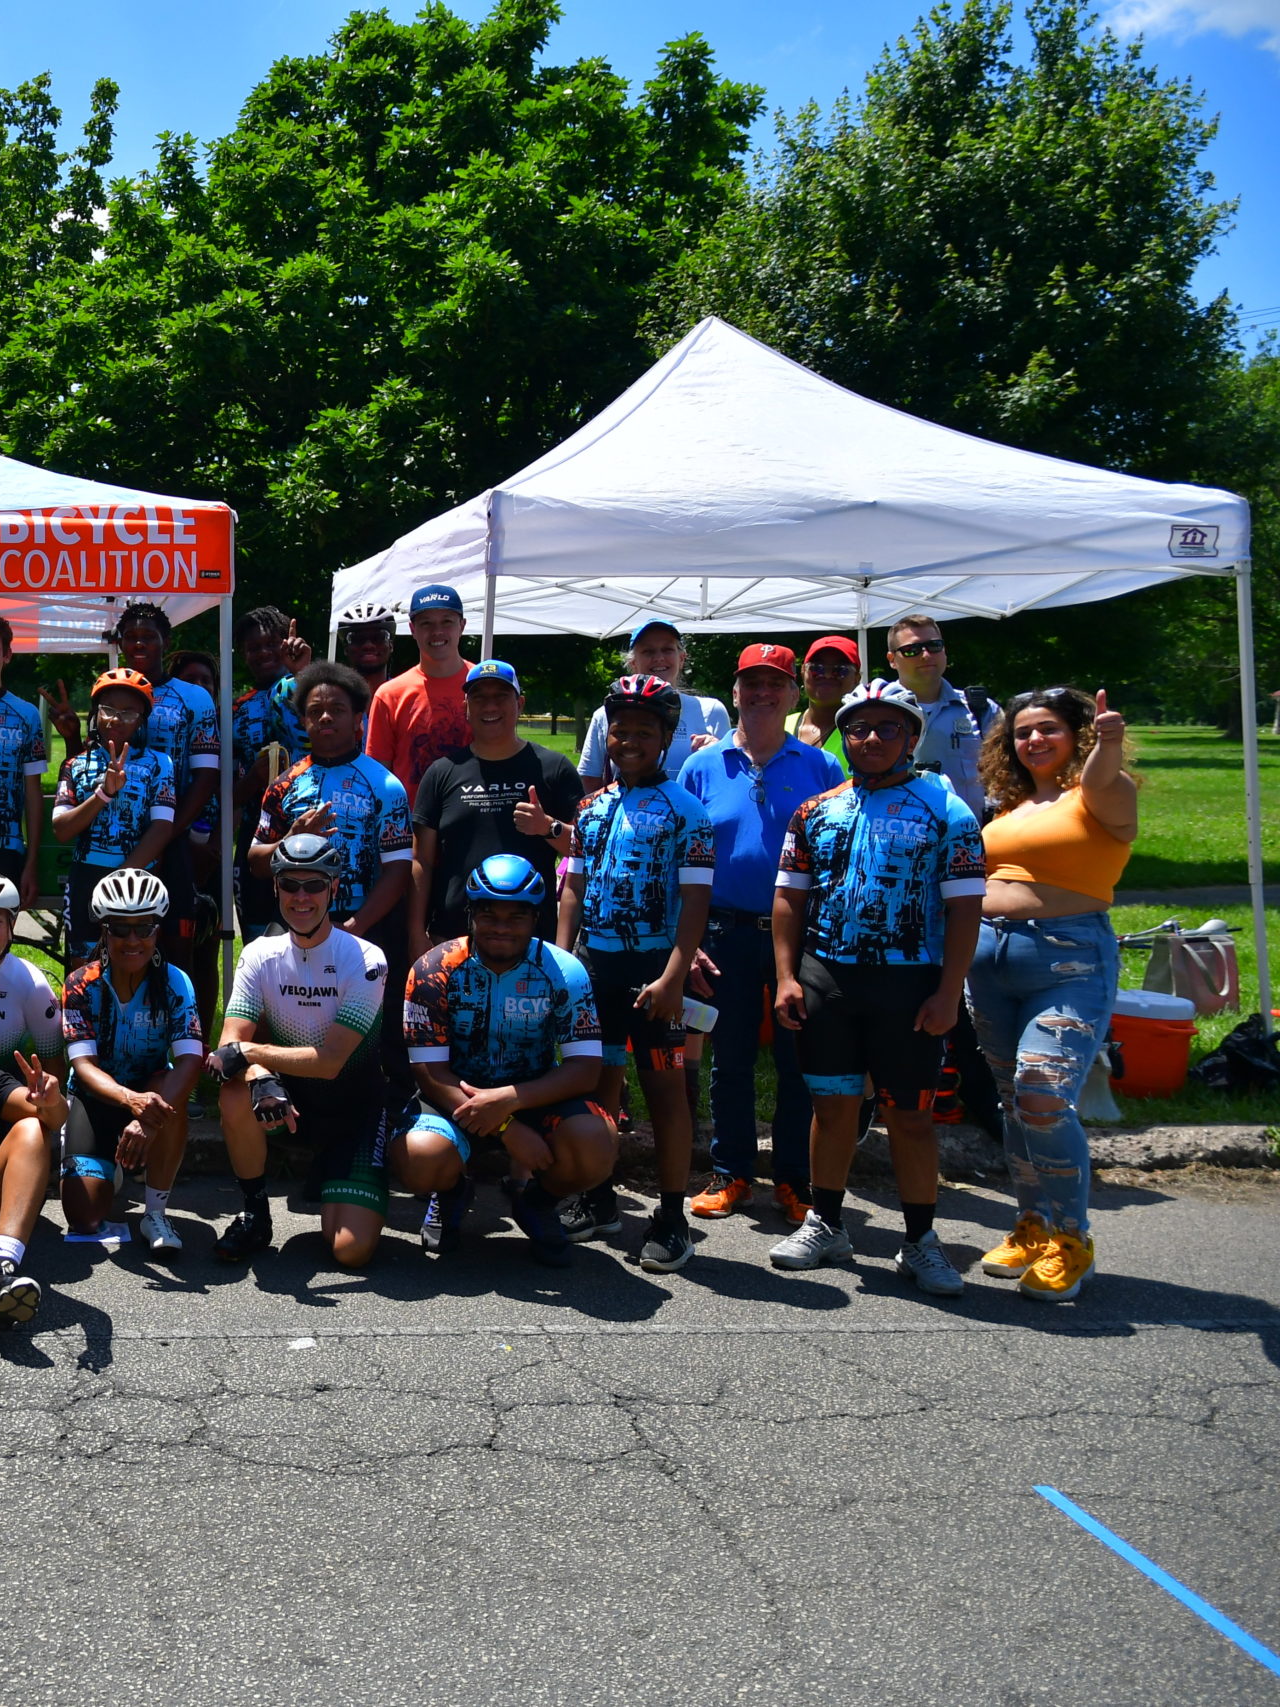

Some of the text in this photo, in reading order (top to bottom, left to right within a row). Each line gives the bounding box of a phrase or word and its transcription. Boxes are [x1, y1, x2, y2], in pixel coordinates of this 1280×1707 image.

[0, 550, 197, 589] COALITION
[420, 593, 450, 603] VARLO
[760, 644, 774, 658] P
[461, 782, 526, 793] VARLO
[332, 791, 371, 810] BCYC
[626, 811, 667, 828] BCYC
[871, 817, 929, 838] BCYC
[504, 996, 552, 1014] BCYC
[322, 1187, 380, 1201] PHILADELPHIA
